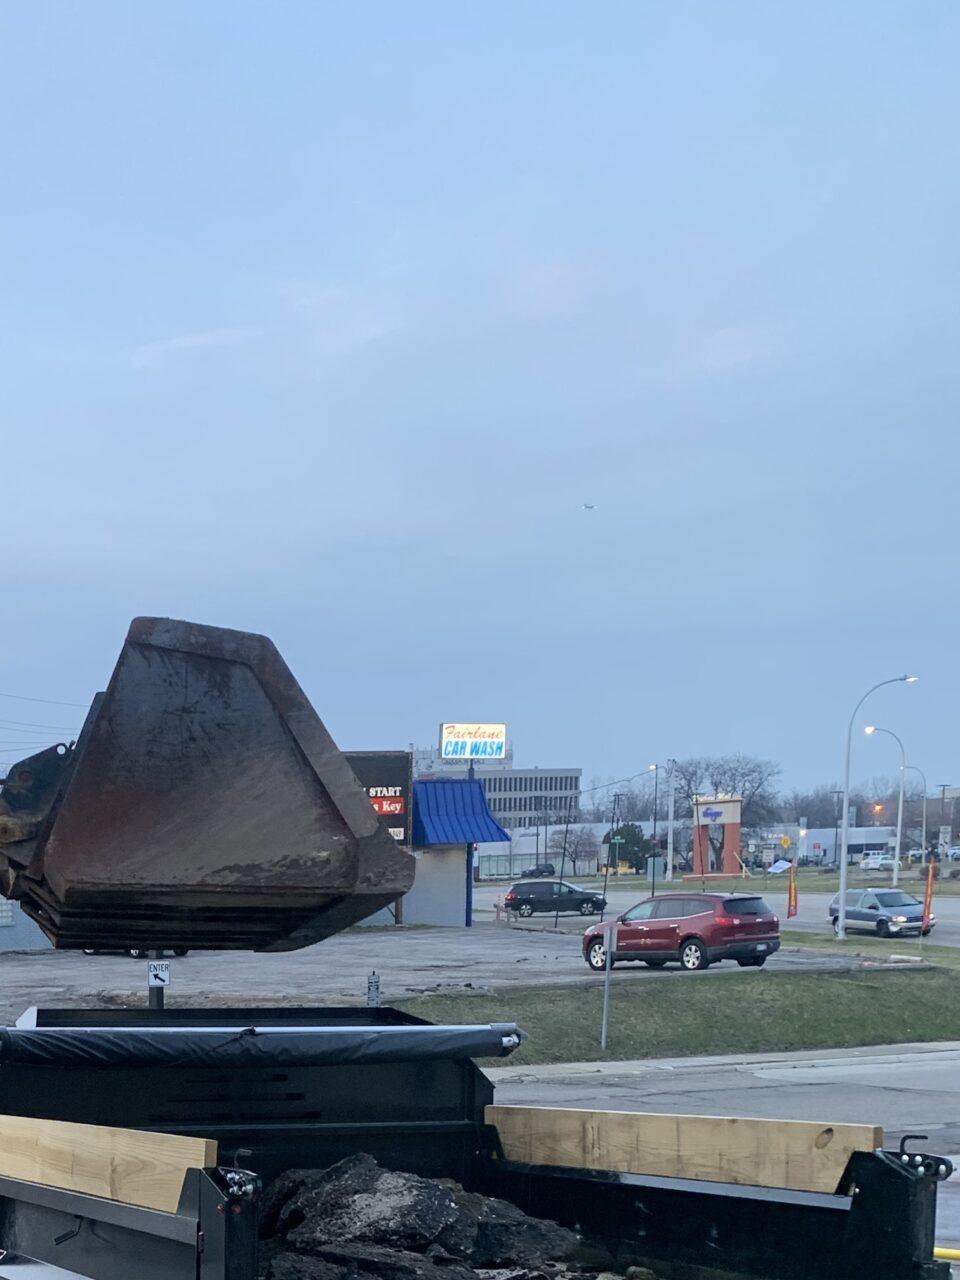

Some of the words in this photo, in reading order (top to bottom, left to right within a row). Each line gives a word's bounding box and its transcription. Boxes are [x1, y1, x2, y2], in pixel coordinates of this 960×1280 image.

[445, 725, 503, 739] Fairlane
[444, 740, 467, 757] CAR
[469, 740, 503, 757] WASH
[369, 786, 402, 796] START
[382, 800, 402, 814] Key
[150, 963, 169, 973] ENTER
